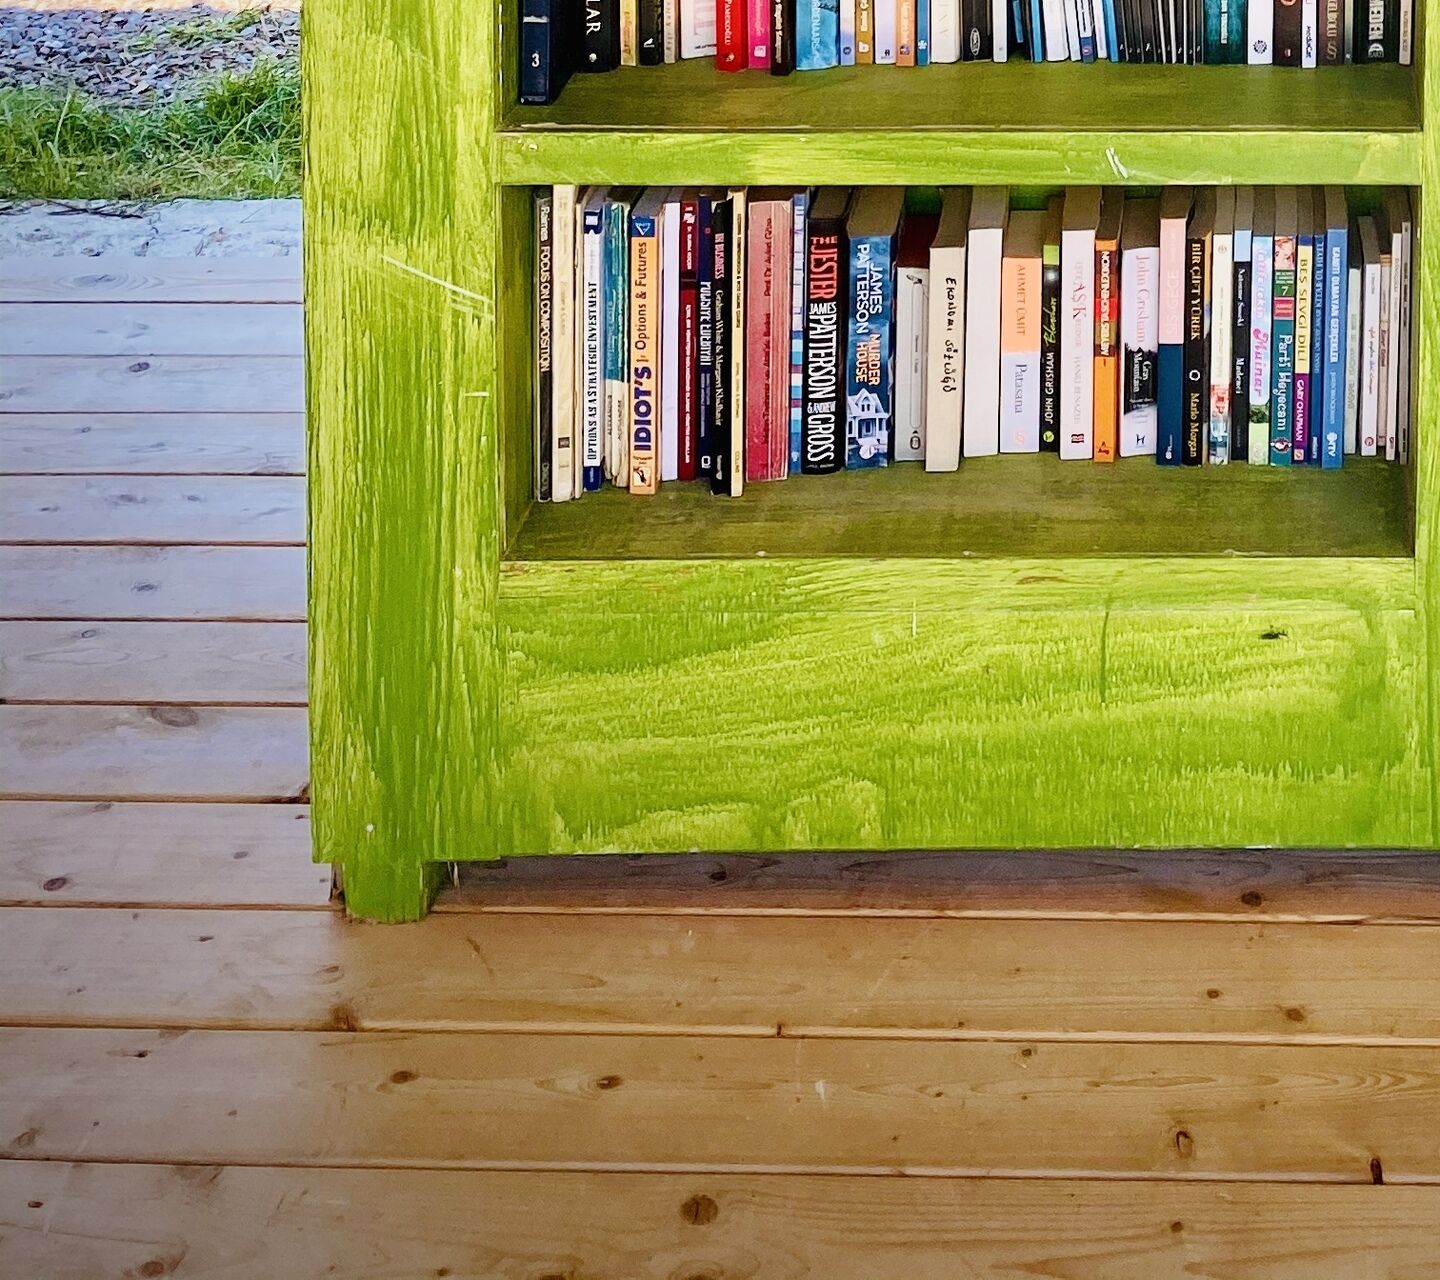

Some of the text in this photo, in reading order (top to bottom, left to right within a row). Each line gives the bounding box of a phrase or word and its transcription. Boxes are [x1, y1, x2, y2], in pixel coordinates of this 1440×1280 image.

[531, 53, 540, 67] 3
[1305, 26, 1313, 58] MediaCat
[811, 236, 838, 245] THE
[540, 206, 551, 371] Raimes FOCUS ON COMPOSITION
[635, 242, 648, 351] Options & Futures
[810, 245, 837, 299] JESTER
[855, 244, 870, 333] PATTERSON
[870, 263, 883, 314] JAMES
[1189, 243, 1202, 340] BİR ÇİFT YÜREK
[1284, 287, 1292, 296] 7
[587, 282, 597, 342] INVESTMENT
[809, 302, 837, 314] JAMES
[1016, 264, 1028, 336] AHMET ÜMİT
[1134, 256, 1151, 342] John Grisham
[1297, 258, 1308, 362] BEŞ SEVGİ DİLİ
[1328, 247, 1340, 363] KANITI OLMAYAN GERÇEKLER
[587, 344, 597, 397] STRATEGIC
[807, 315, 837, 399] PATTERSON
[855, 341, 868, 383] HOUSE
[868, 333, 880, 385] MURDER
[1132, 353, 1143, 393] Mountain
[1141, 361, 1152, 381] Gray
[1235, 357, 1245, 394] Madenci
[1253, 328, 1268, 397] Muinar
[587, 407, 597, 418] AS
[633, 366, 651, 451] IDIOT'S
[1014, 364, 1028, 414] Patasana
[1045, 352, 1055, 424] JOHN GRISHAM
[1295, 379, 1304, 441] GARY CHAPMAN
[587, 421, 597, 460] OPTIONS
[807, 414, 835, 461] GROSS
[1189, 393, 1199, 457] Marlo Morgan
[1328, 441, 1337, 457] NTV
